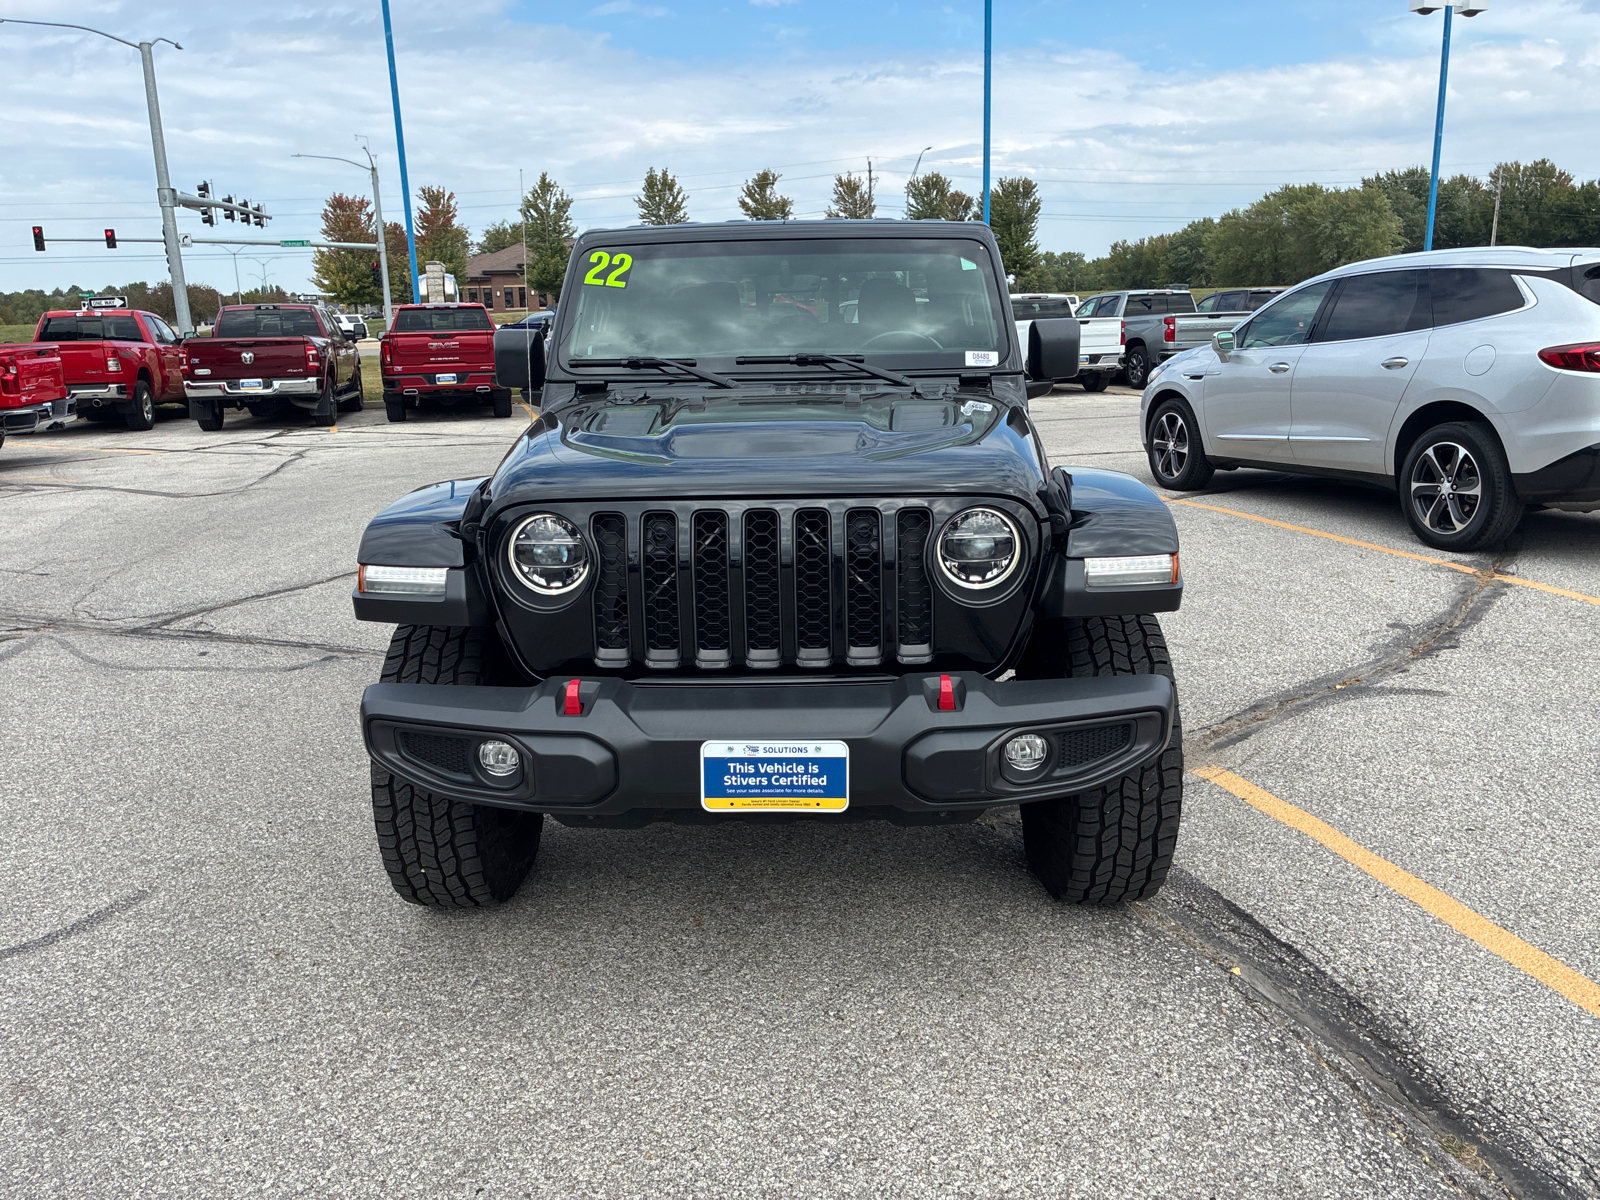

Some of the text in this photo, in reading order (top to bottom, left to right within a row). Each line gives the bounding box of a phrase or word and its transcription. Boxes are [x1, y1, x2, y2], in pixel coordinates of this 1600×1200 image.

[583, 251, 633, 289] 22
[428, 342, 460, 350] GMC
[728, 762, 819, 774] This Vehicle is
[724, 774, 827, 786] Stivers Certified
